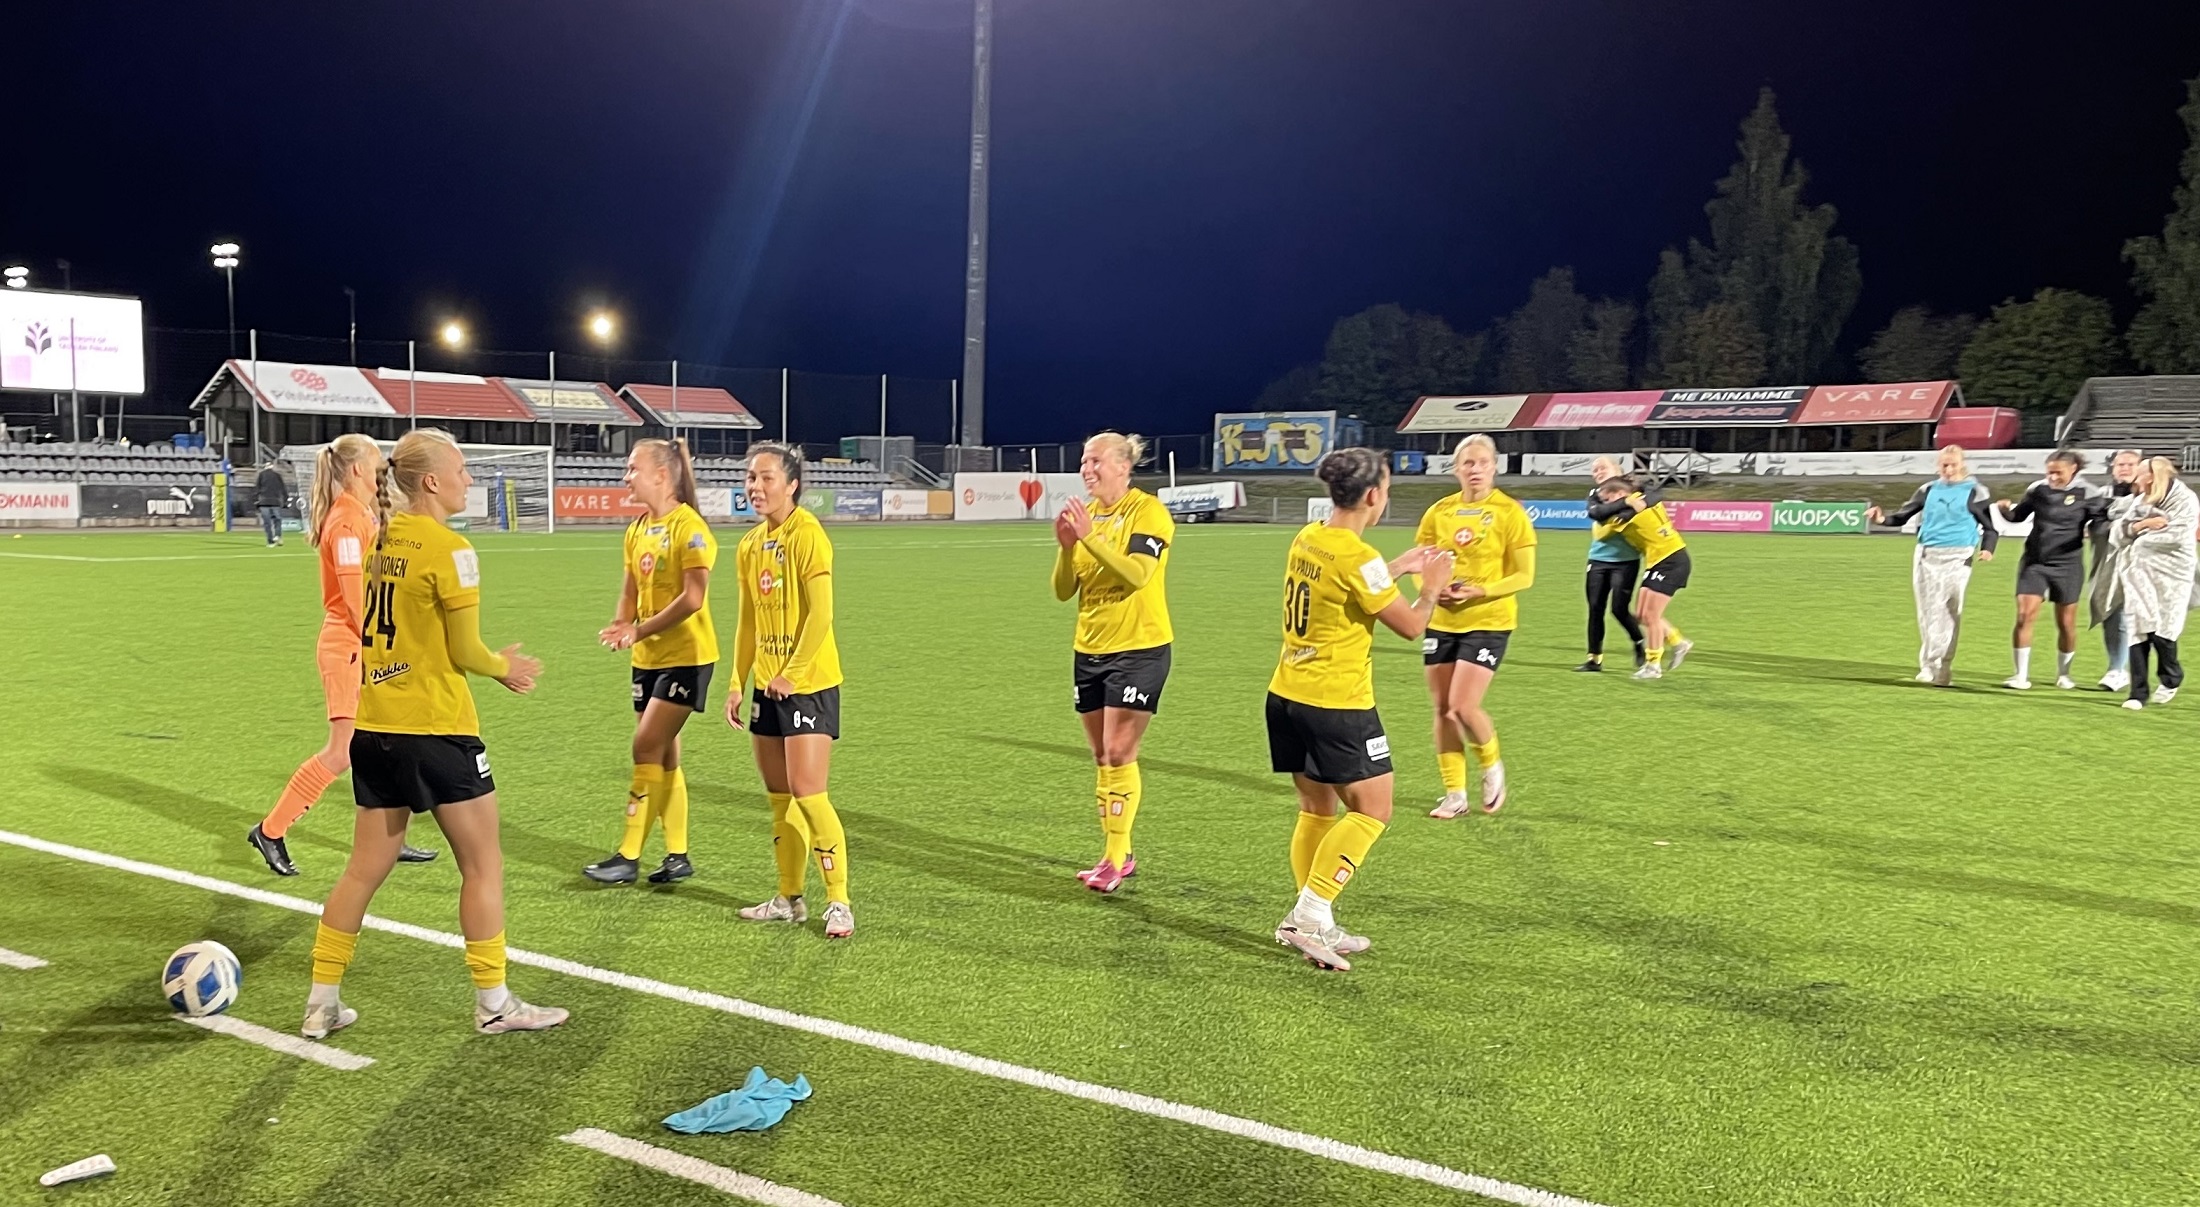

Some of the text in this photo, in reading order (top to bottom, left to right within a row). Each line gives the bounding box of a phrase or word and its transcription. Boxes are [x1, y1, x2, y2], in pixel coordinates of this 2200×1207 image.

[1671, 390, 1795, 402] ME PAINAMME
[362, 580, 396, 650] 24
[1284, 576, 1310, 638] 30
